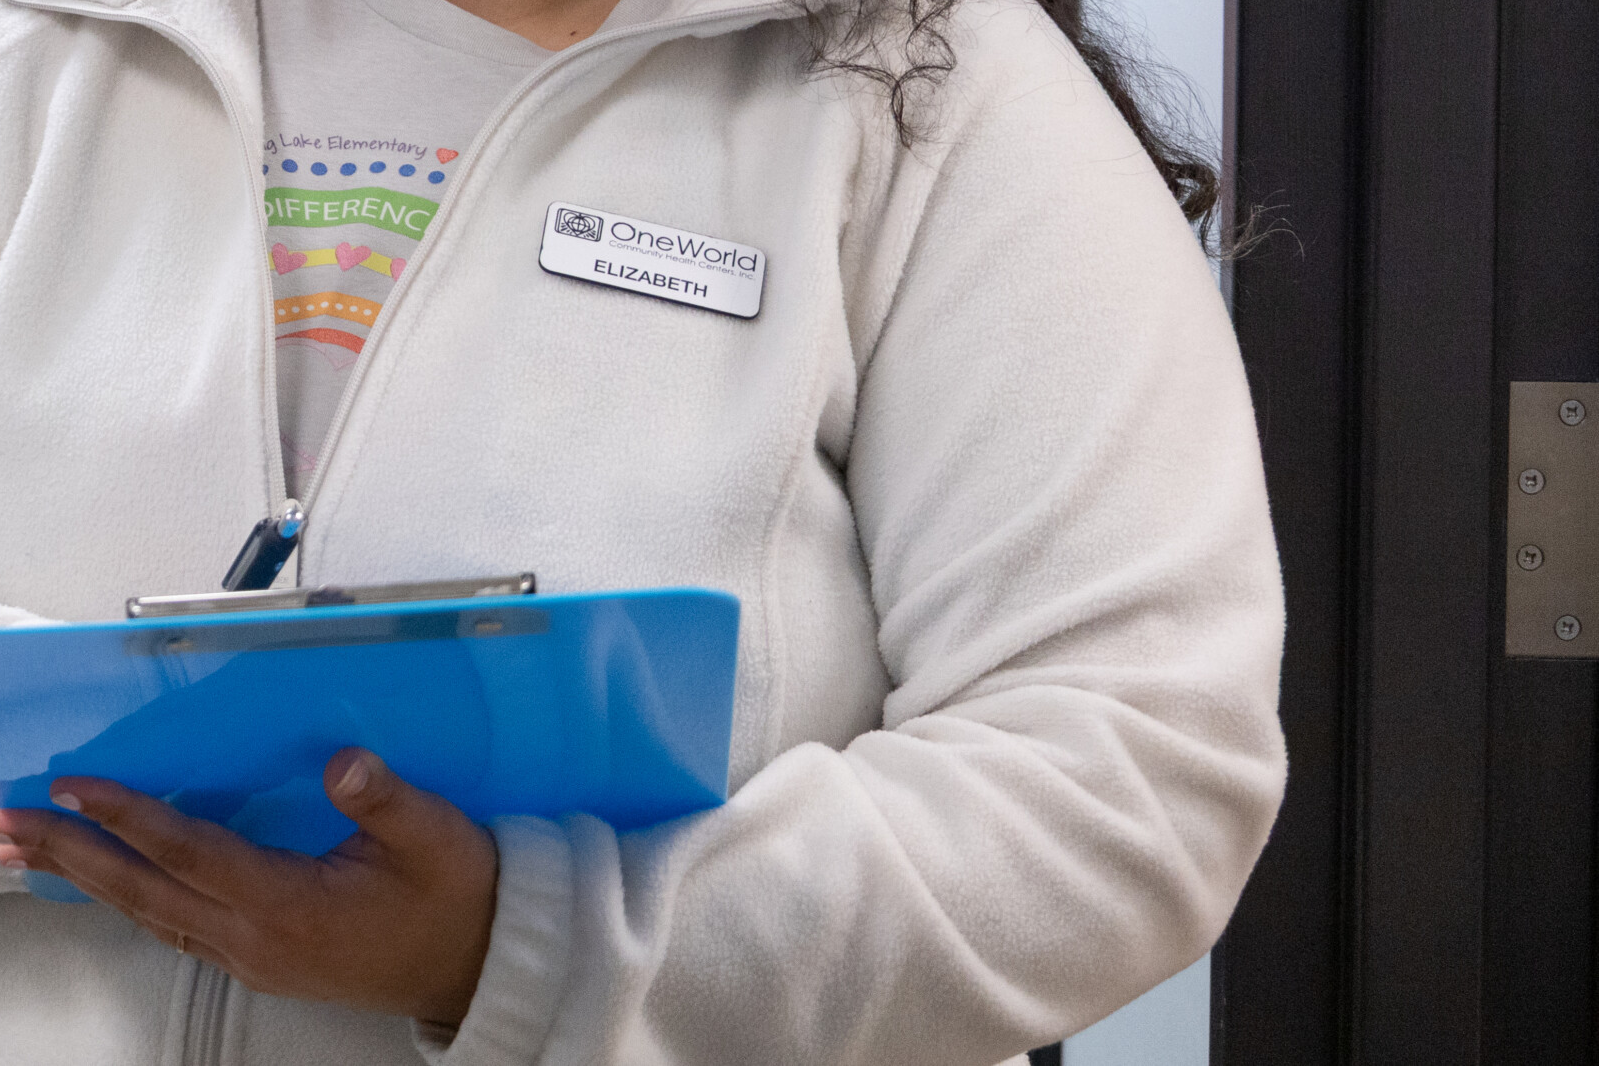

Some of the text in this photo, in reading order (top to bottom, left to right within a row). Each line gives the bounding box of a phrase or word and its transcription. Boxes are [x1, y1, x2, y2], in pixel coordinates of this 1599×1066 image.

[279, 133, 323, 149] Lake
[327, 135, 428, 161] Elementary
[608, 239, 664, 259] Community
[665, 252, 696, 267] Health
[610, 221, 758, 273] OneWorld
[593, 258, 709, 298] ELIZABETH
